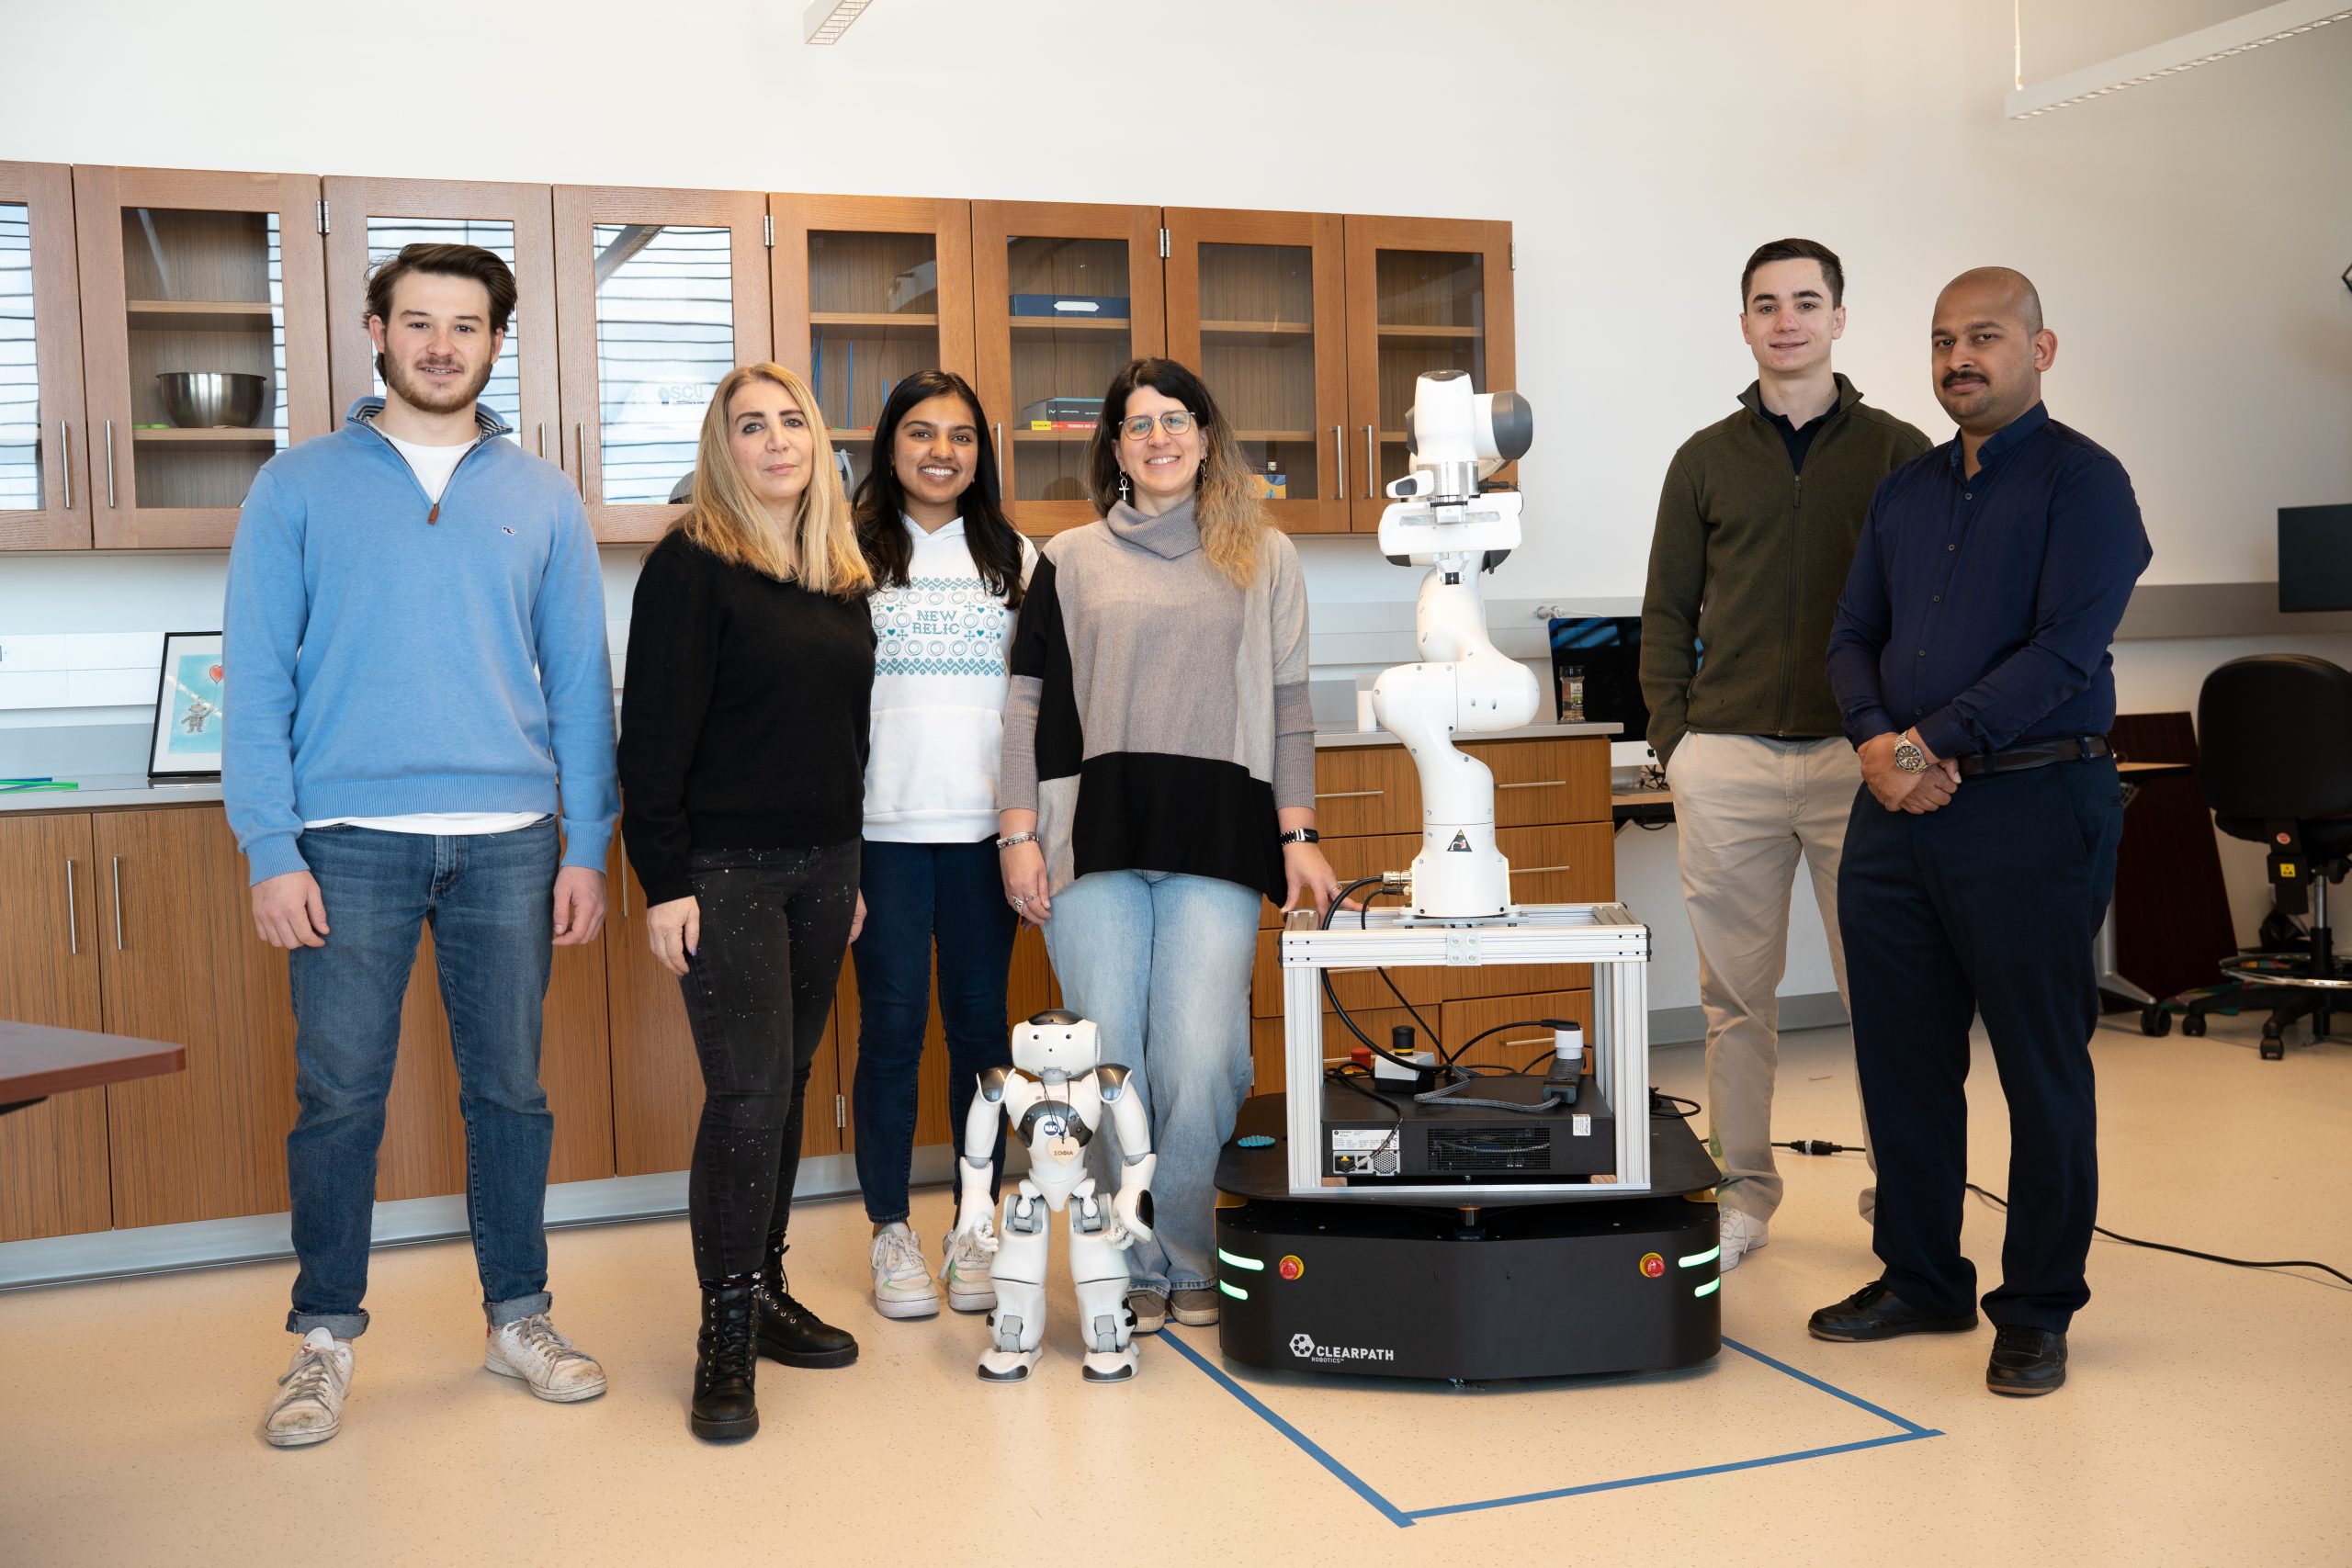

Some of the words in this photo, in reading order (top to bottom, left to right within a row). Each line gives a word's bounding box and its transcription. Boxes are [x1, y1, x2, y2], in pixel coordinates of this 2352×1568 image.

[916, 609, 957, 622] NEW
[912, 622, 960, 635] RELIC
[1316, 1346, 1395, 1361] CLEARPATH
